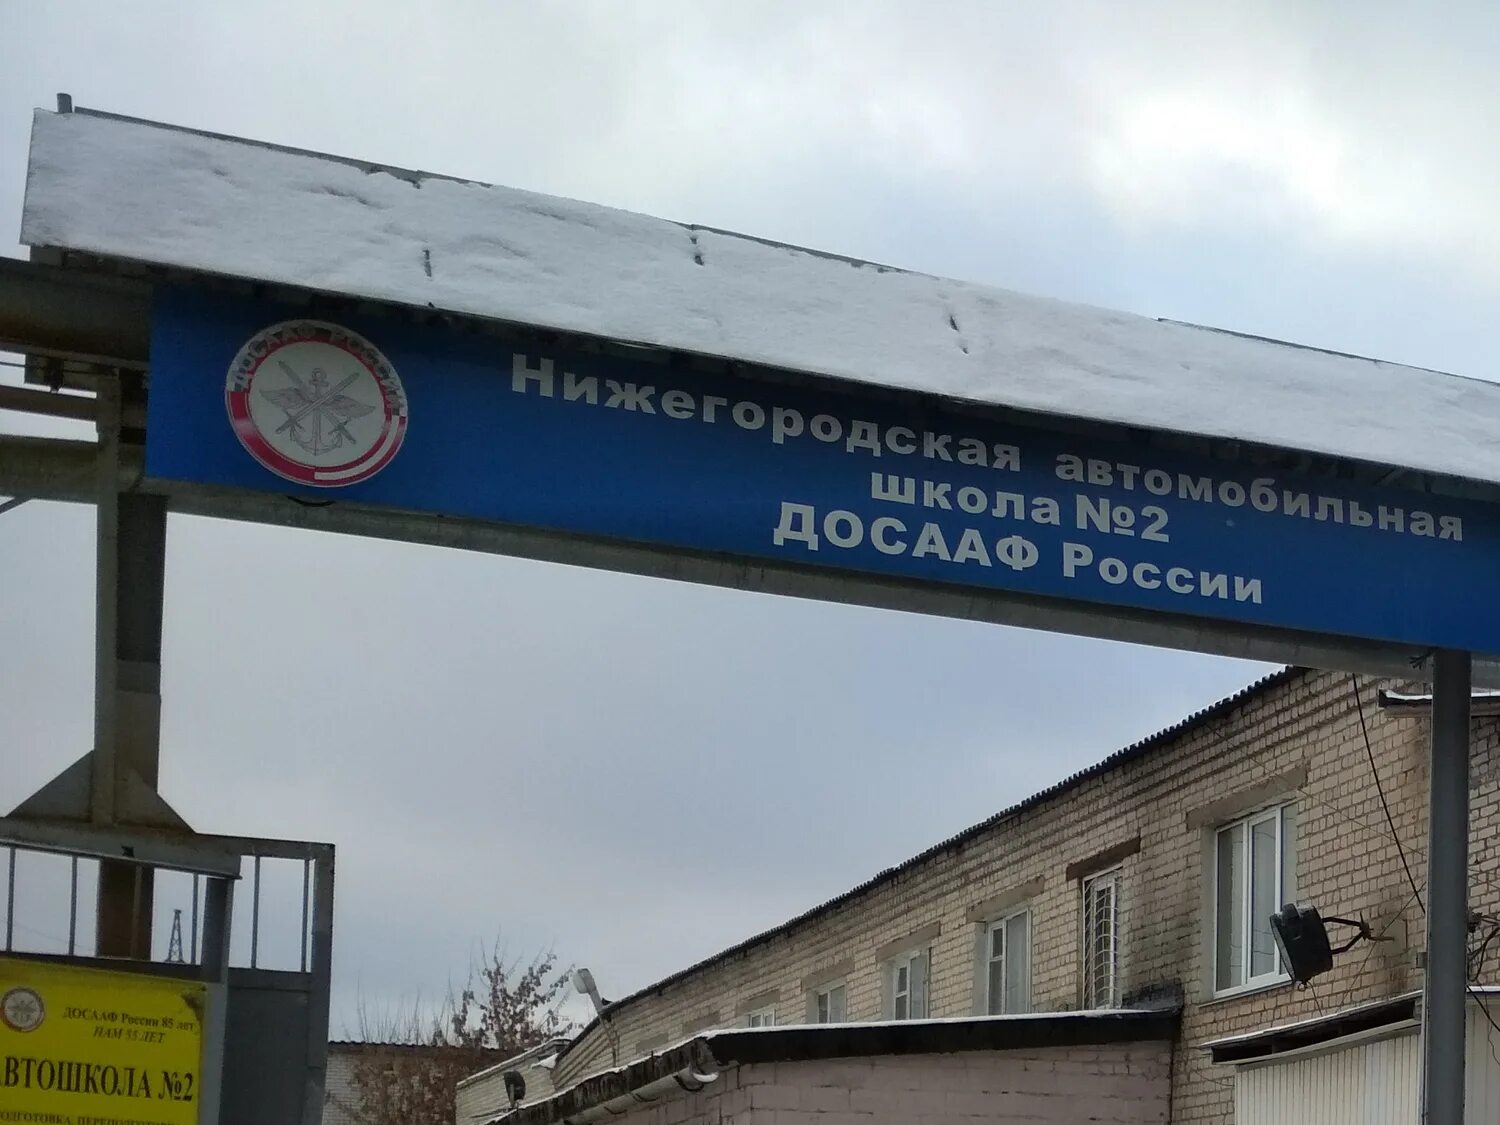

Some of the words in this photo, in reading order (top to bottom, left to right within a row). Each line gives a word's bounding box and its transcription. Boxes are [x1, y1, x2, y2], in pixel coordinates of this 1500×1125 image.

[512, 353, 1021, 472] Нижегородская
[1055, 453, 1464, 542] автомобильная
[871, 472, 1060, 526] школа
[1076, 494, 1170, 543] №2
[773, 501, 1040, 571] ДОСААФ
[1062, 542, 1263, 604] России
[63, 1007, 118, 1022] ДОСААФ
[121, 1013, 159, 1027] России
[161, 1016, 173, 1029] 85
[0, 1055, 153, 1099] ВТОШКОЛА
[158, 1070, 194, 1102] №2
